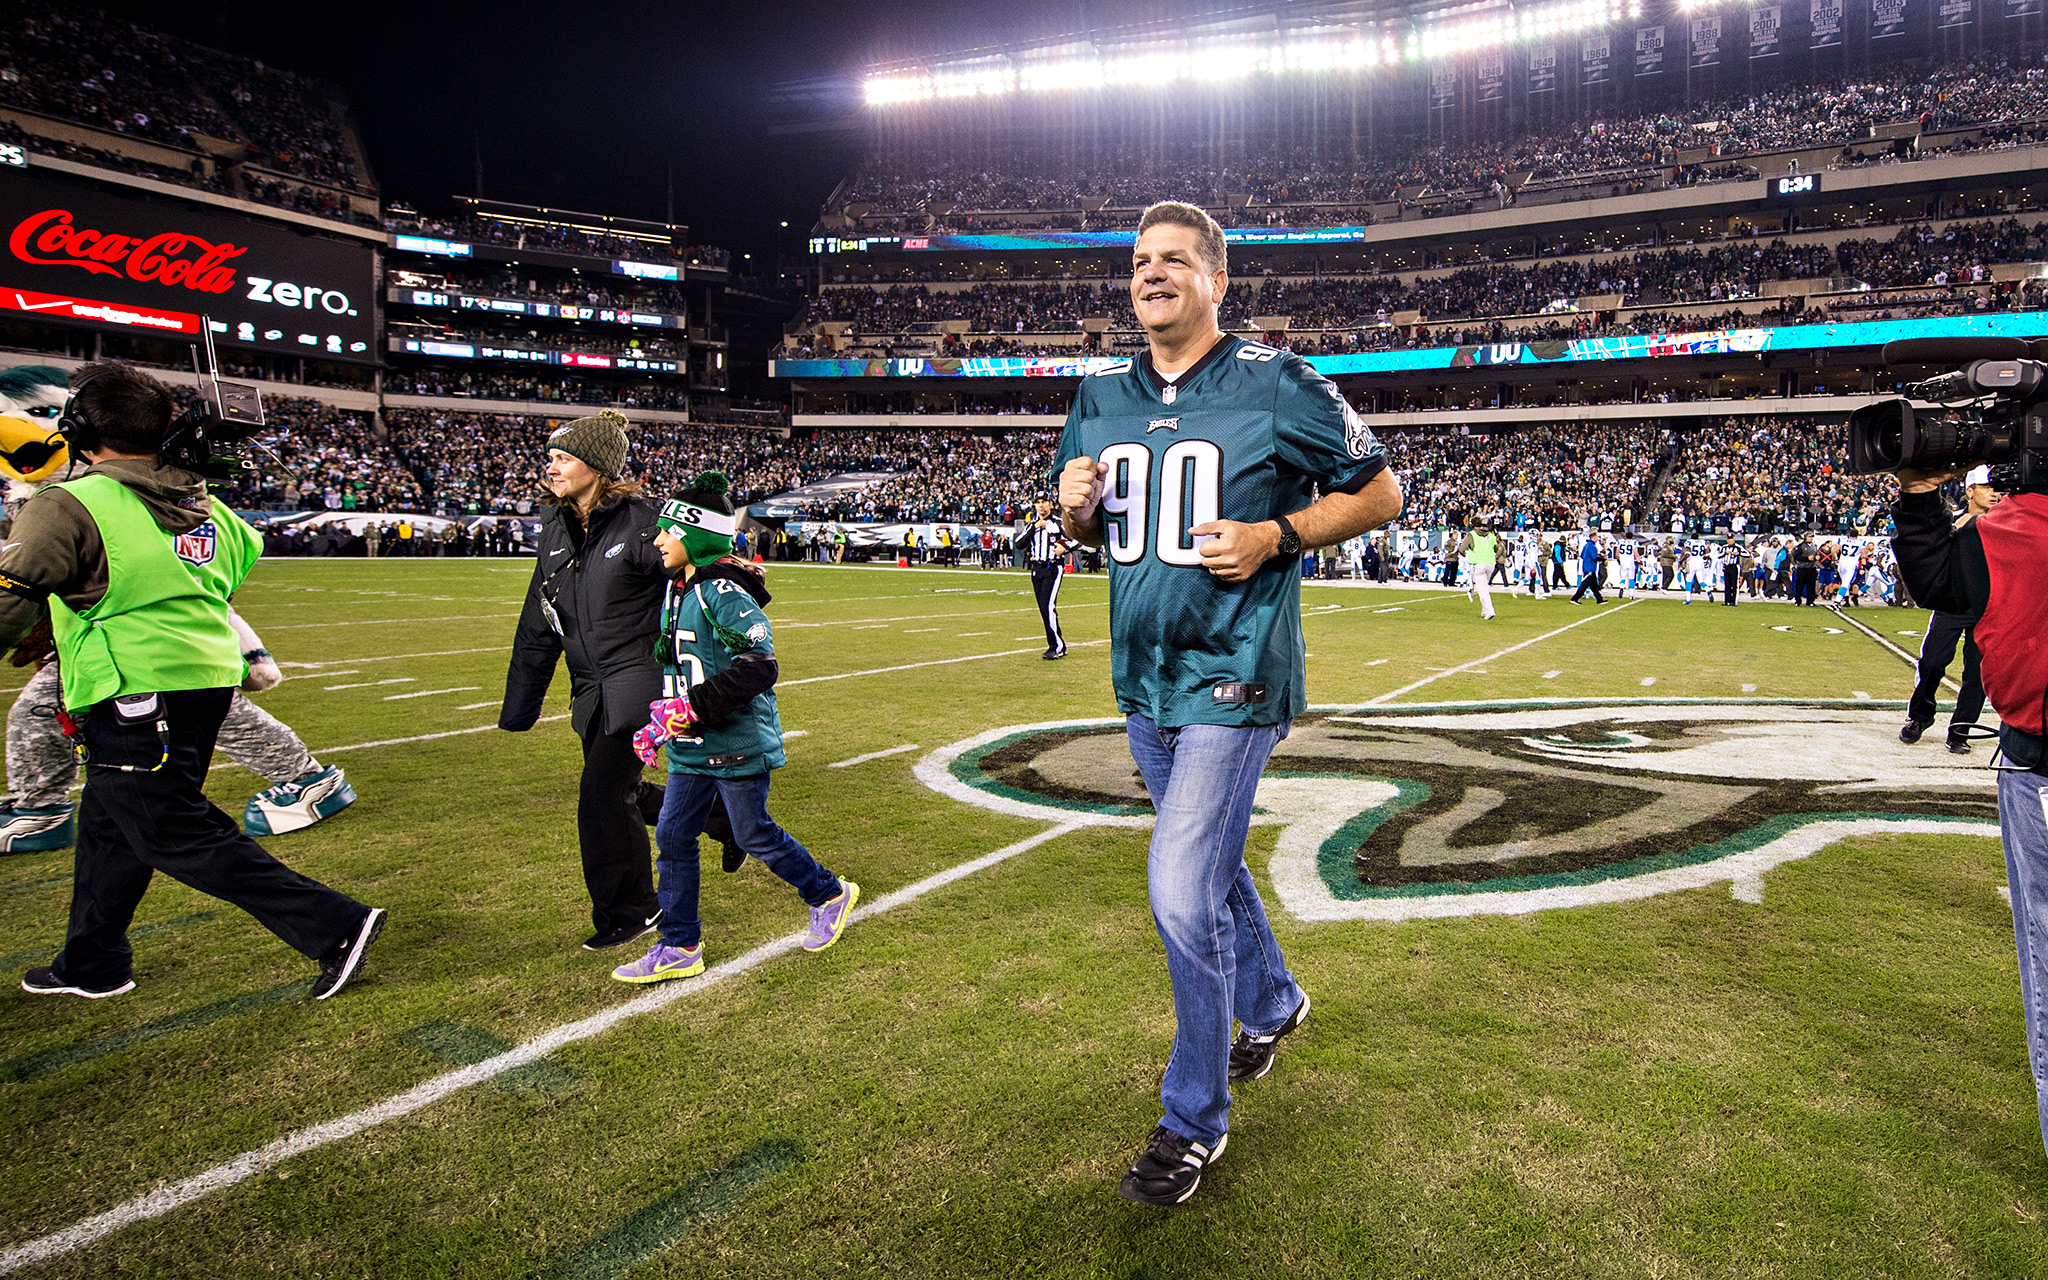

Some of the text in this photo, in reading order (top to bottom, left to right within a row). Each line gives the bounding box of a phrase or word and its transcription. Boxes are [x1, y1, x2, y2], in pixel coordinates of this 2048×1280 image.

[1813, 7, 1840, 20] 2002
[1753, 18, 1777, 31] 2001
[1695, 28, 1718, 40] 1988
[1640, 38, 1661, 50] 1980
[1586, 48, 1607, 60] 1960
[1779, 175, 1813, 193] 0:34
[903, 238, 929, 249] ACME
[9, 209, 248, 294] Coca-Cola
[246, 276, 357, 317] zero.
[433, 294, 449, 306] 31
[460, 296, 475, 309] 17
[1098, 439, 1224, 567] 90
[660, 501, 703, 524] LES
[178, 534, 211, 561] NFL
[1619, 543, 1634, 556] 59
[1690, 544, 1706, 557] 58
[1841, 543, 1860, 557] 67
[662, 629, 706, 698] 5
